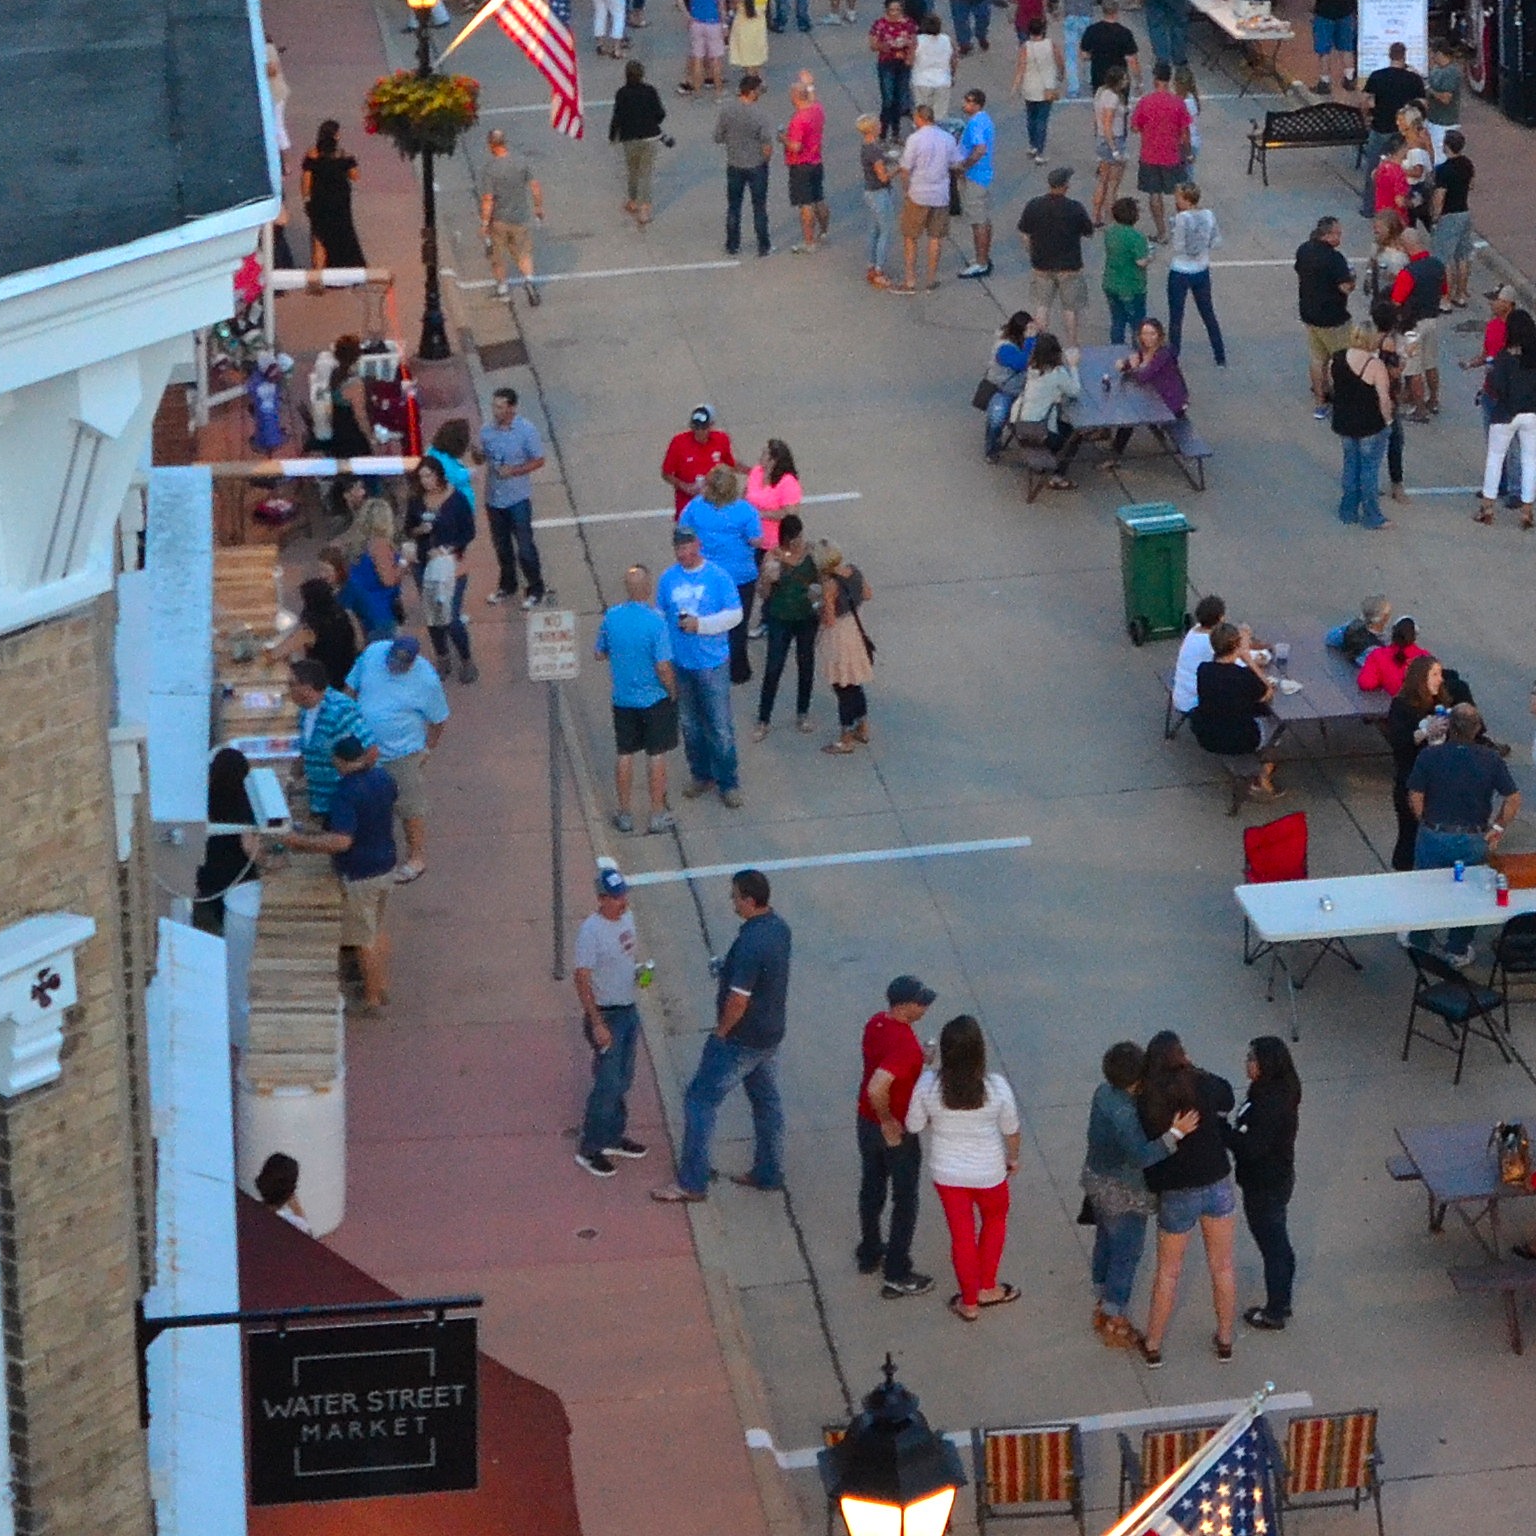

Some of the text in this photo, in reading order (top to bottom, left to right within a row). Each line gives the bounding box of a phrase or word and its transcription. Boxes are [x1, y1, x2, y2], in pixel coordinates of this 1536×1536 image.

[263, 1384, 468, 1420] WATER STREET
[301, 1416, 429, 1443] MARKET
